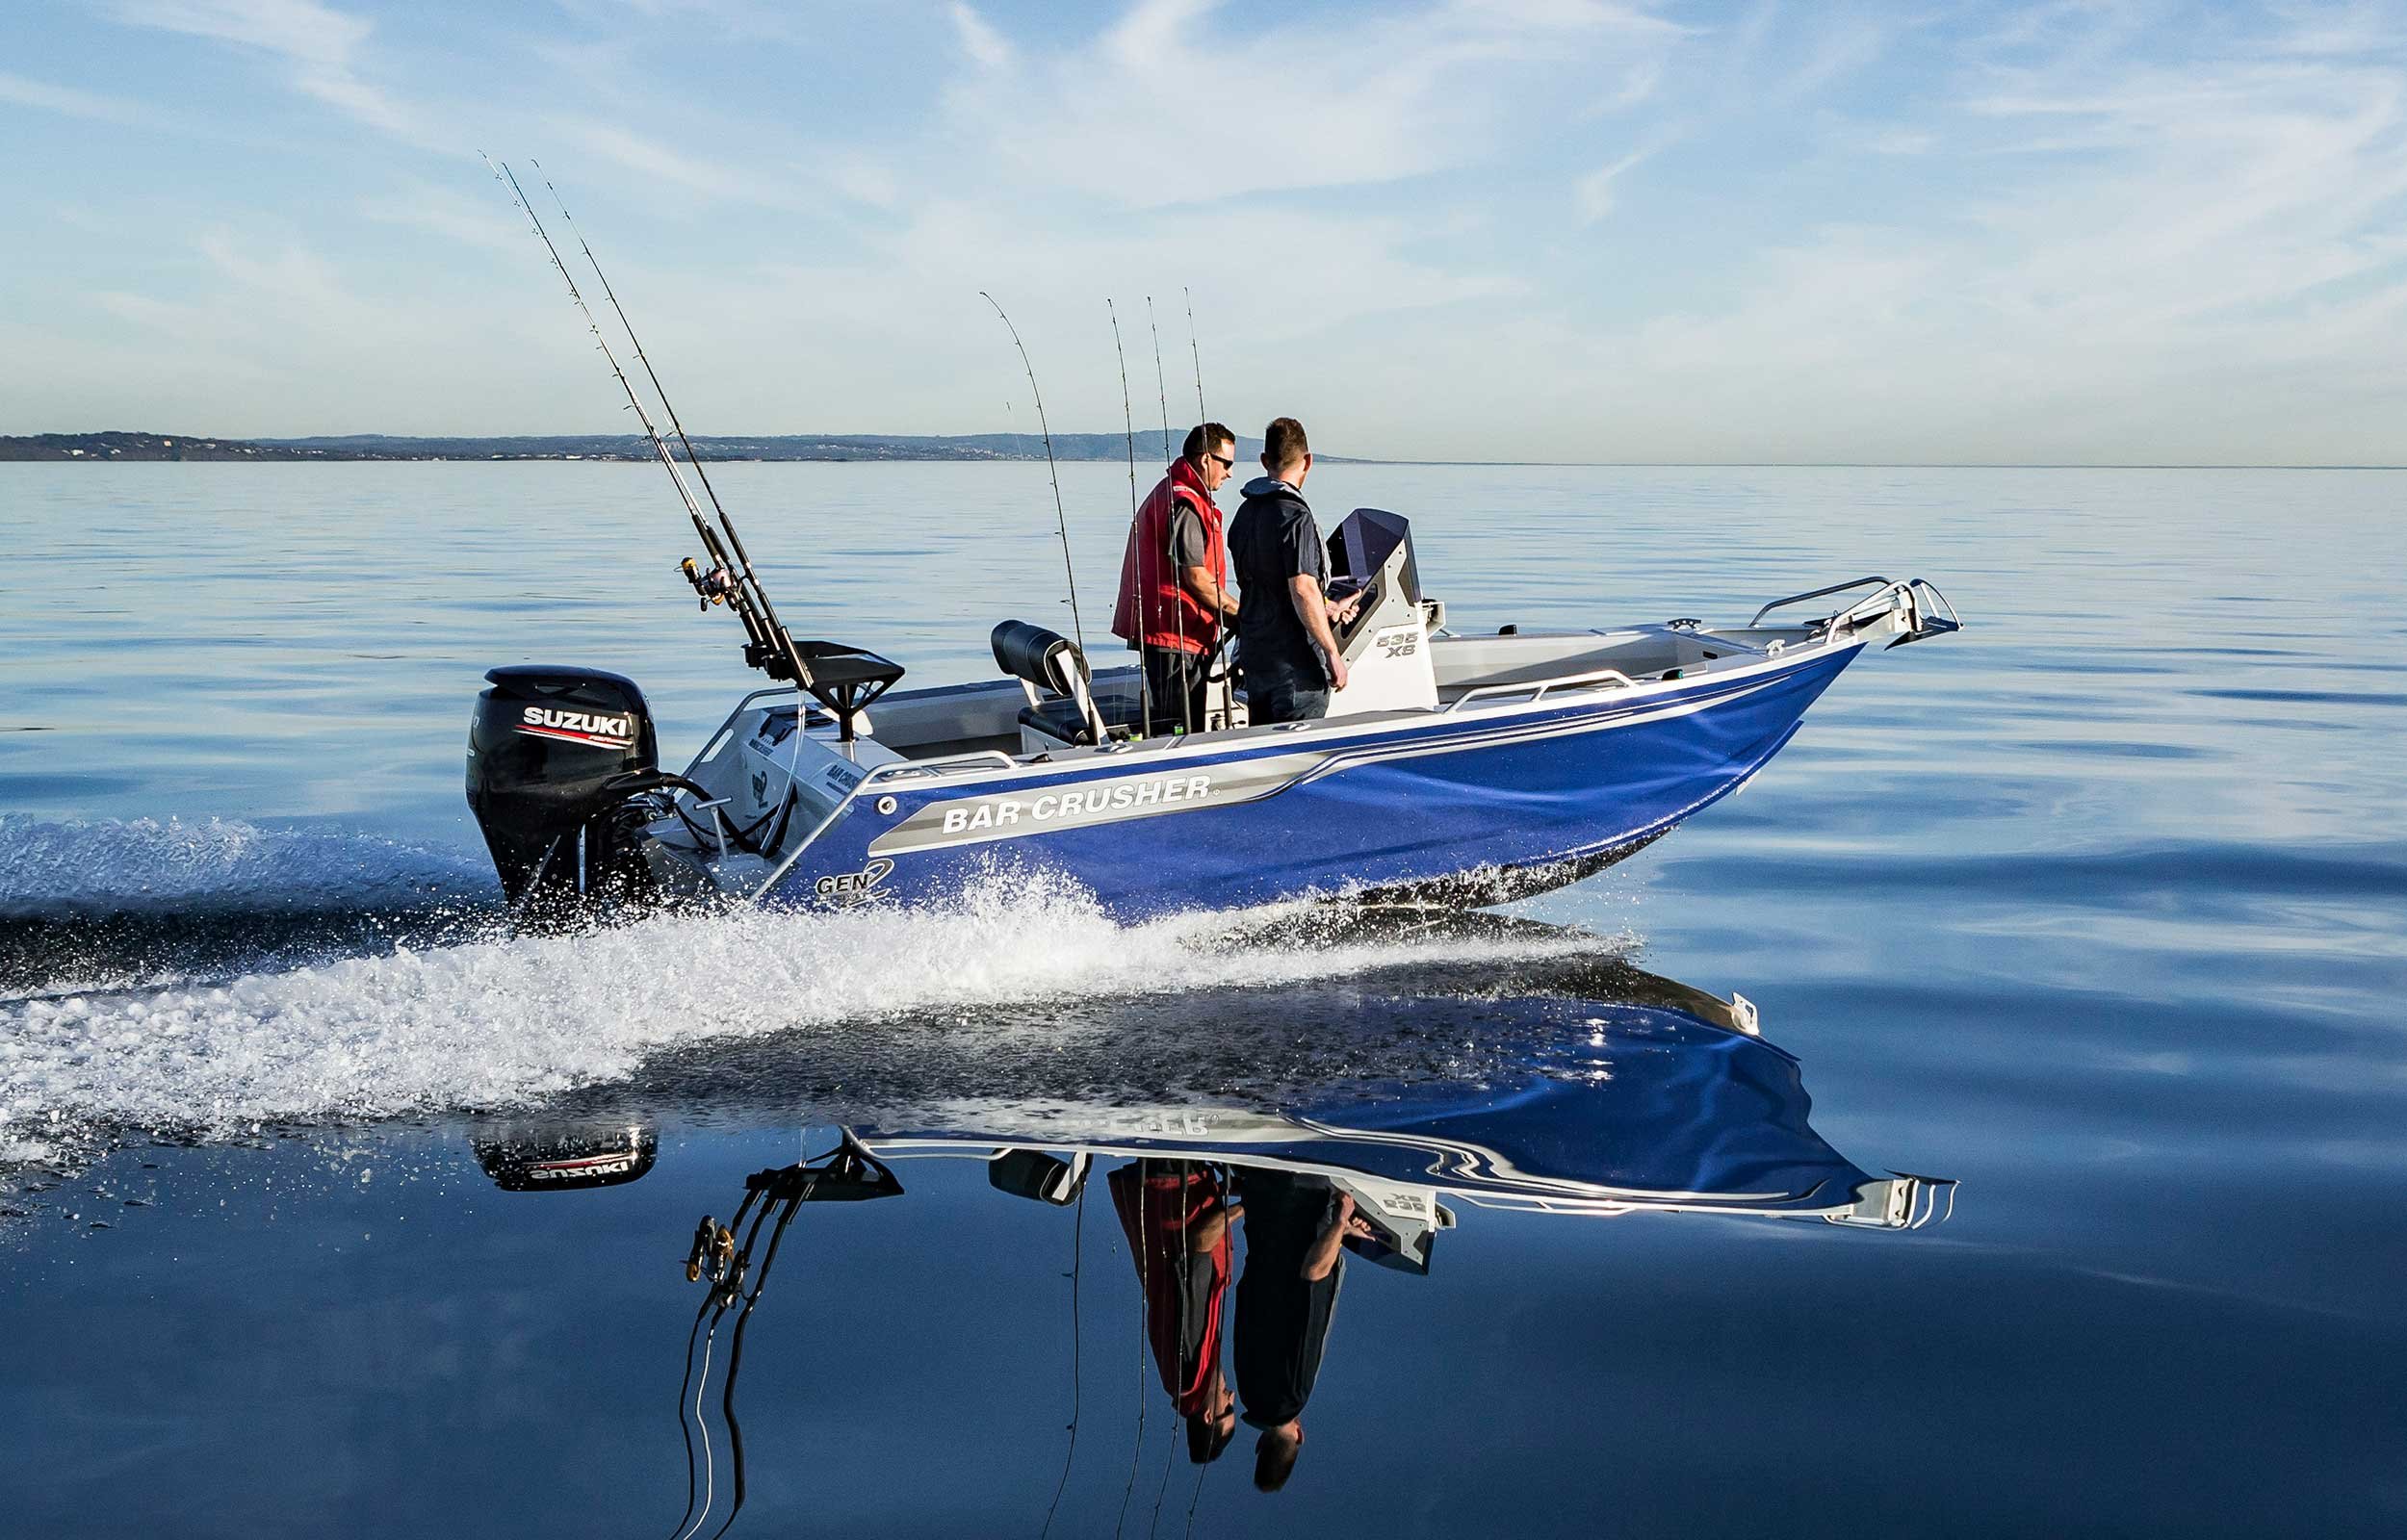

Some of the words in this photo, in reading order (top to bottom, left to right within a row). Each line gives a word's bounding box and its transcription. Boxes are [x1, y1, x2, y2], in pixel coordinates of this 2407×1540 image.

[523, 706, 627, 737] SUZUKI
[942, 800, 1022, 834] BAR
[1031, 775, 1212, 821] CRUSHER
